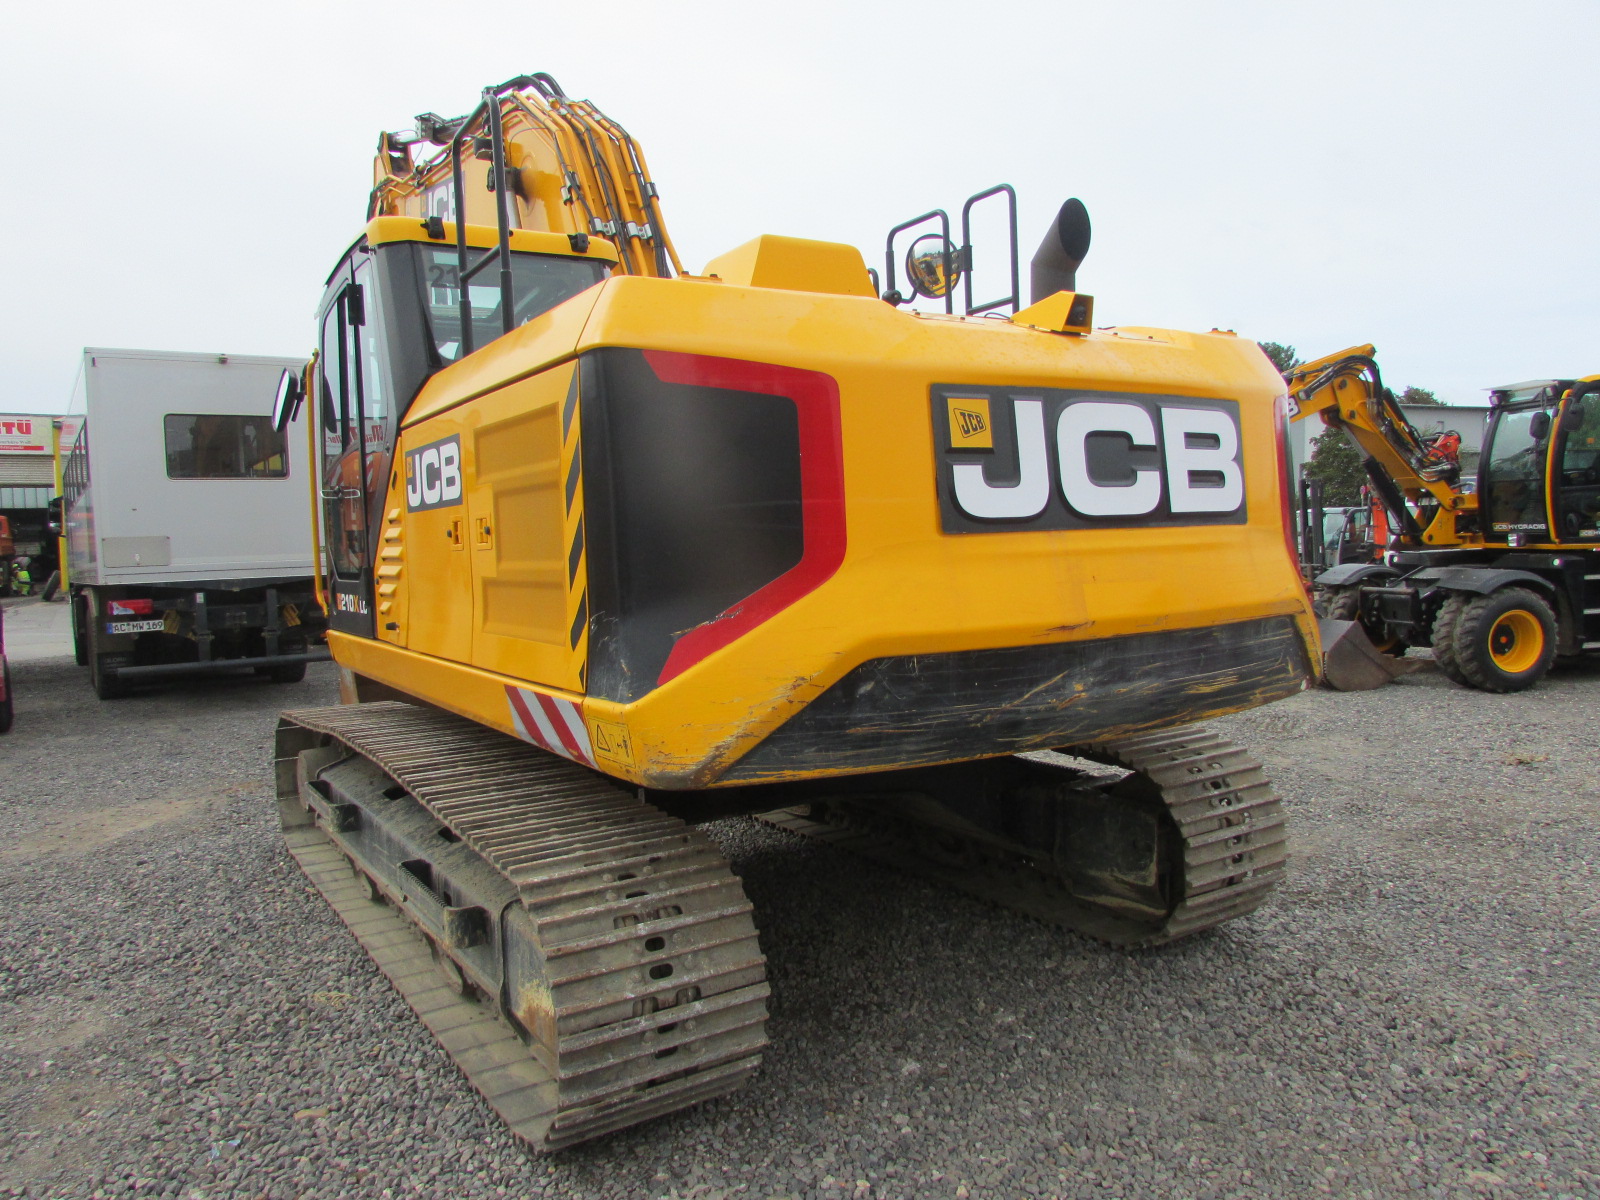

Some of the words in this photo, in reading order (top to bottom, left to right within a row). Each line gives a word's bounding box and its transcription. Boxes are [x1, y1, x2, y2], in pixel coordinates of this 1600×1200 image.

[0, 419, 32, 435] TÜ
[959, 411, 985, 435] JCB
[952, 399, 1244, 518] JCB
[407, 441, 462, 507] JCB
[114, 624, 126, 633] AC
[132, 622, 145, 631] MW
[146, 621, 163, 631] 169
